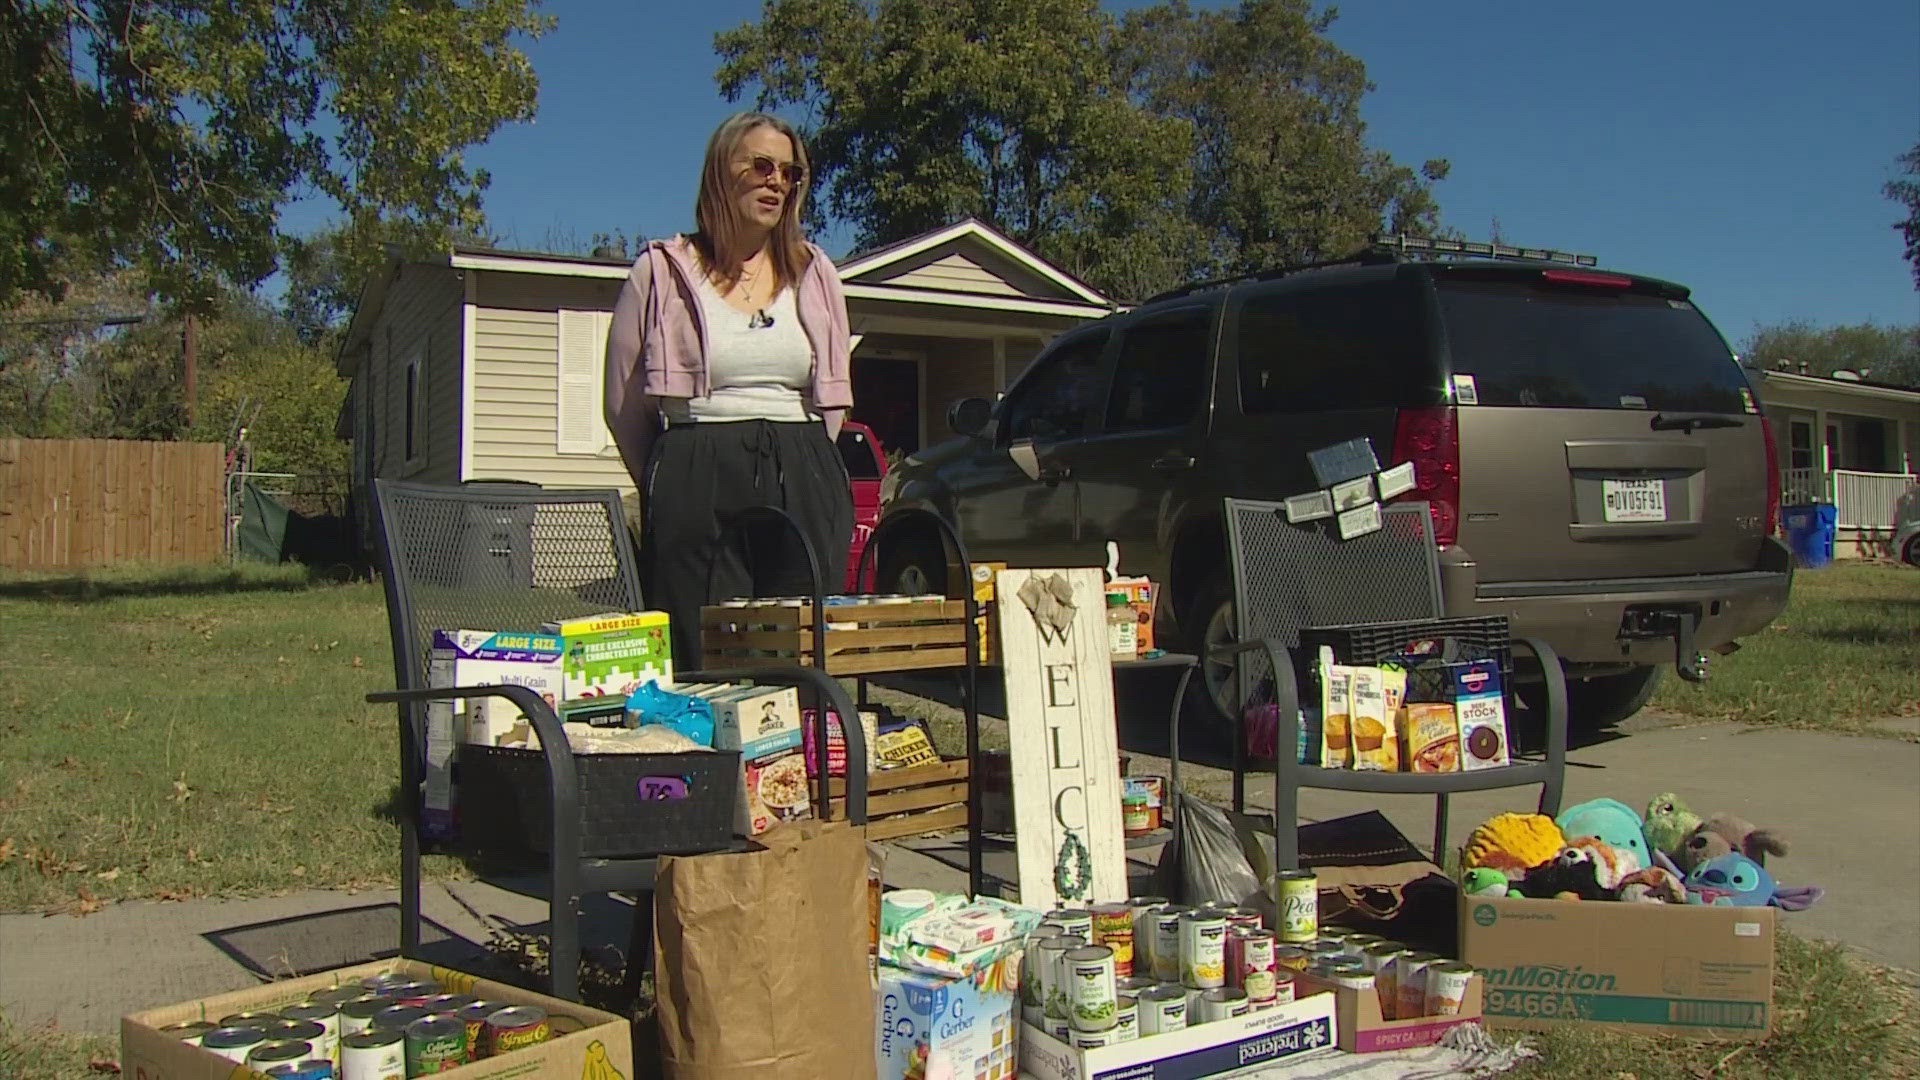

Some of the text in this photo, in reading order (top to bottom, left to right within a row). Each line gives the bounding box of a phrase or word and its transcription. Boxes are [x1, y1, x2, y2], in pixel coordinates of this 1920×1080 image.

[1620, 480, 1648, 488] TEXAS
[590, 618, 641, 632] LARGE SIZE
[495, 635, 530, 649] LARGE
[532, 637, 557, 650] SIZE
[585, 637, 648, 653] FREE EXCLUSIVE
[585, 646, 649, 662] CHARACTER ITEM
[500, 674, 522, 687] Multi
[524, 677, 547, 688] Grain
[1463, 707, 1497, 718] STOCK
[758, 721, 784, 735] QUAKER
[884, 739, 929, 760] CHICKEN
[1483, 987, 1579, 1017] 9466A
[881, 994, 899, 1058] Gerber
[940, 1016, 975, 1039] Gerber
[1375, 1033, 1401, 1045] SPICY
[1239, 1030, 1299, 1065] Preferred
